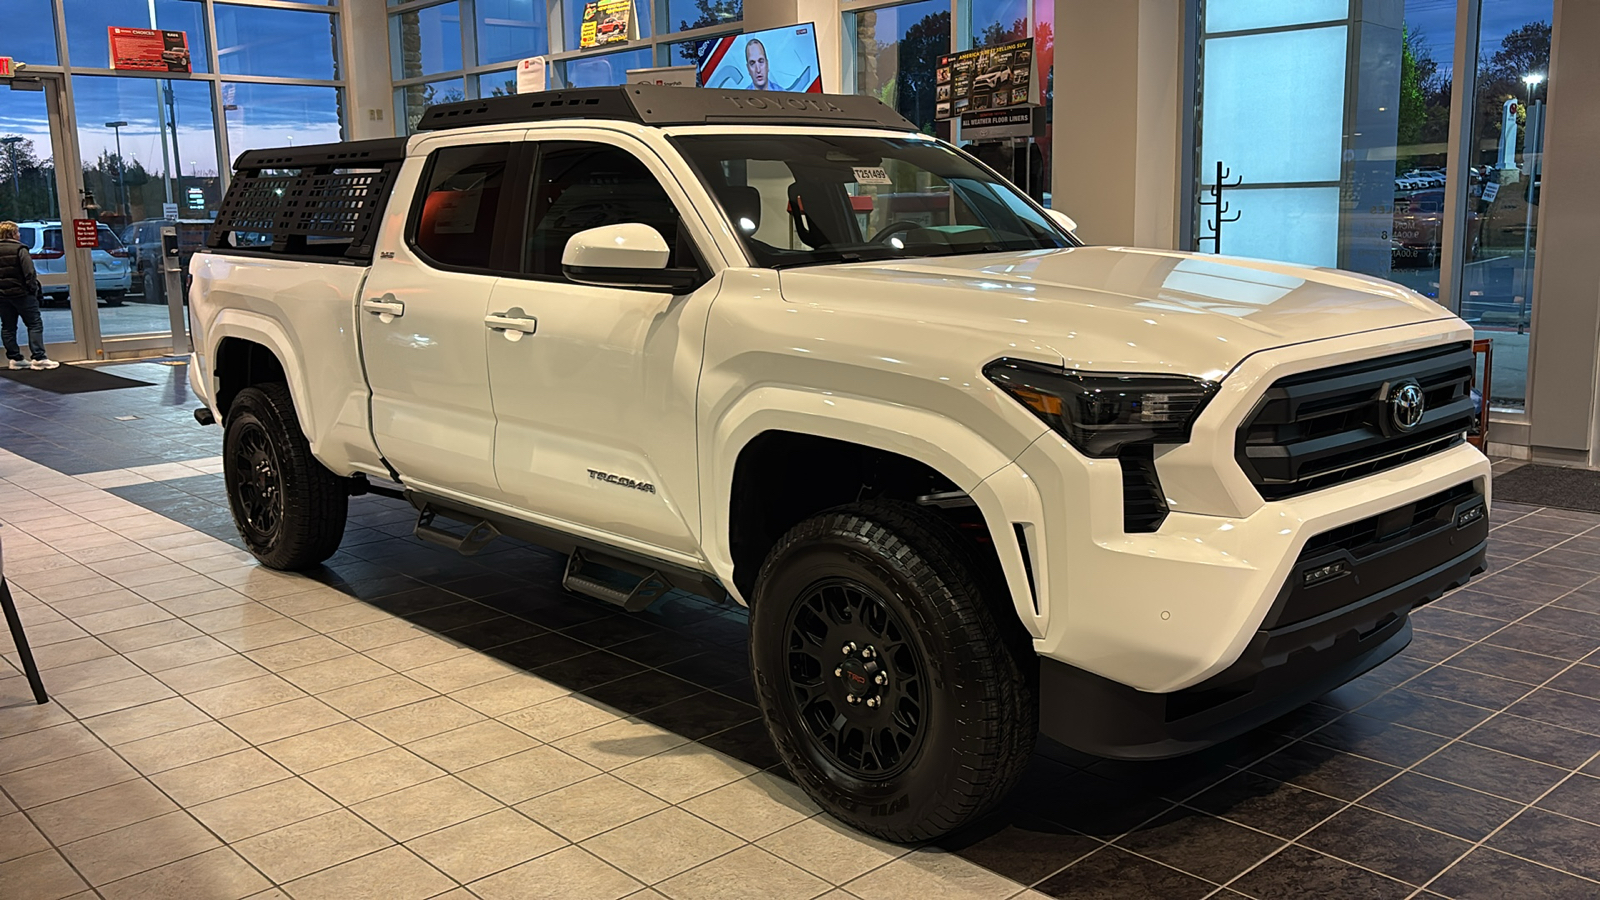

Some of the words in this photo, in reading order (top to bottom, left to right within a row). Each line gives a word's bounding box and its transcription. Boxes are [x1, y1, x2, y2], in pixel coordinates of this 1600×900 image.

[959, 51, 984, 60] AMERICA'S
[722, 95, 845, 113] TOYOTA
[992, 116, 1009, 124] FLOOR
[1009, 114, 1029, 122] LINERS
[855, 169, 886, 179] T251499
[846, 670, 865, 684] TRD
